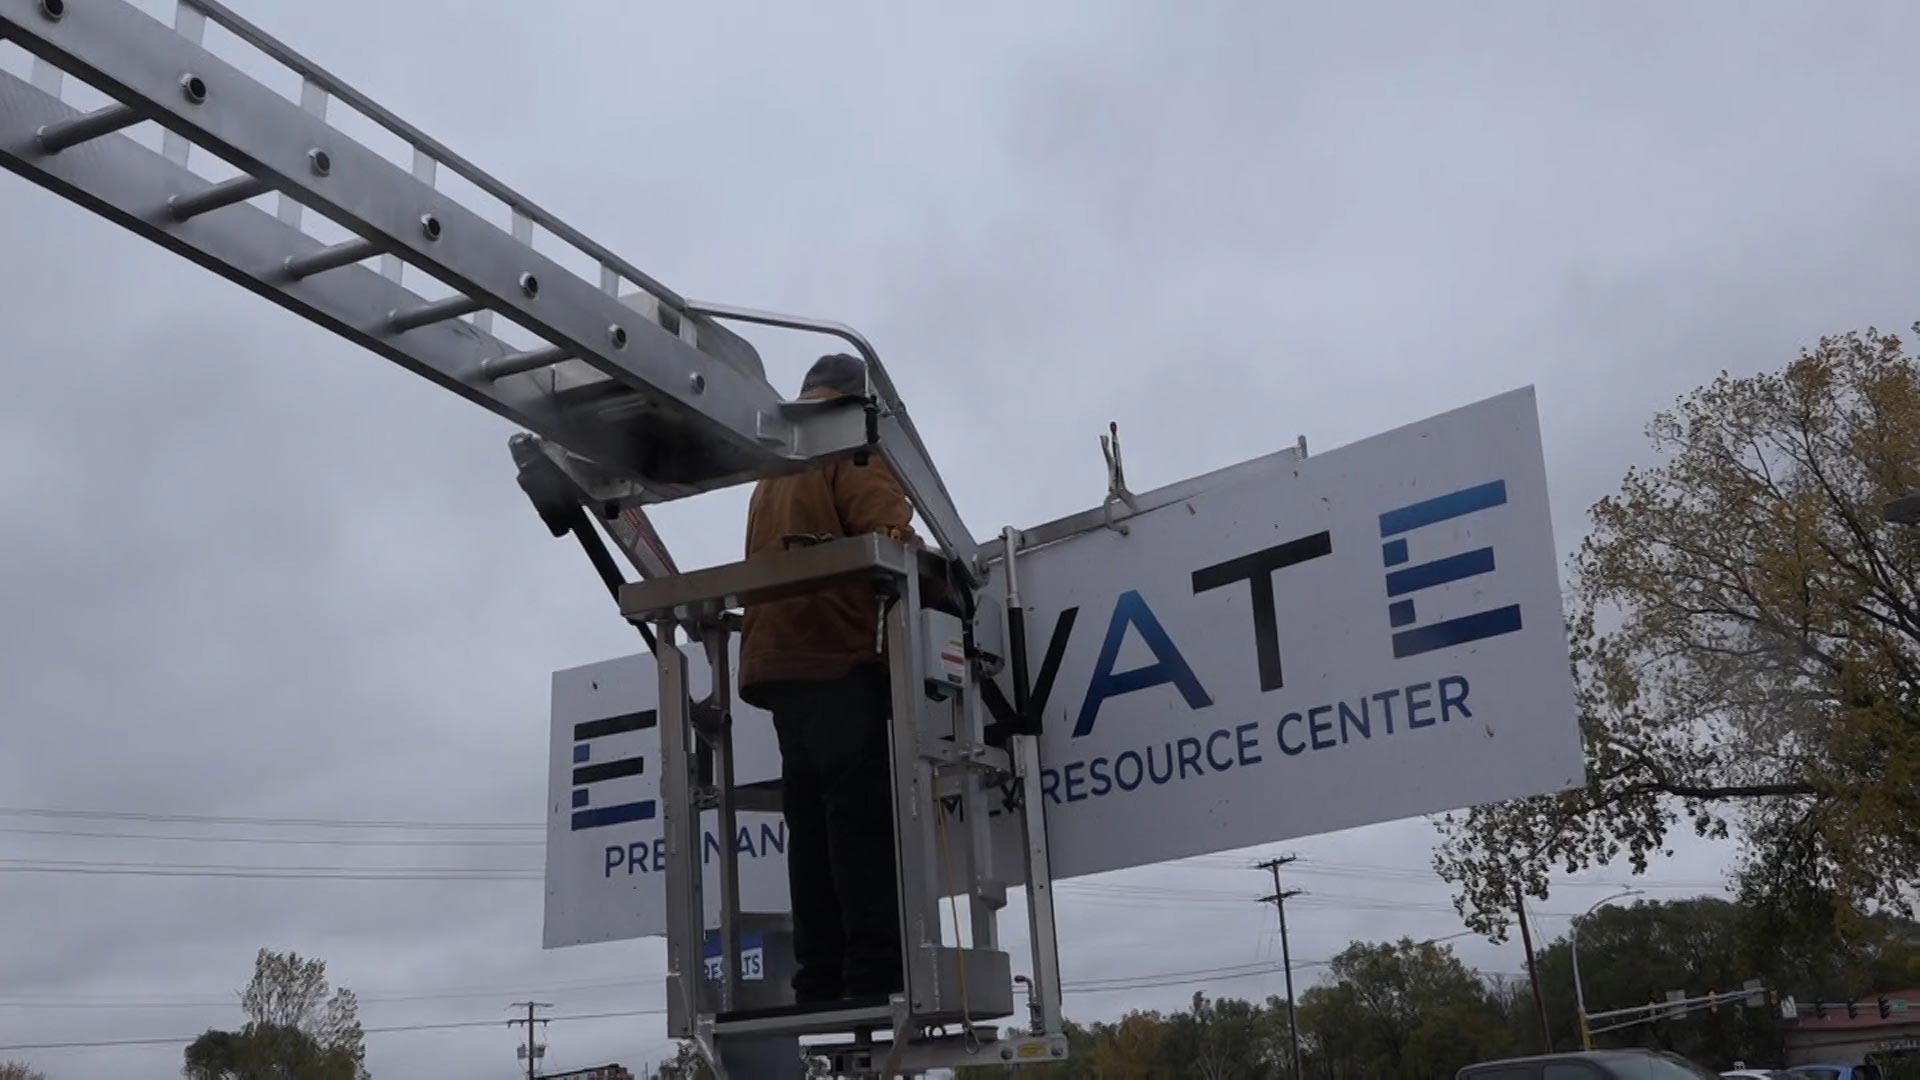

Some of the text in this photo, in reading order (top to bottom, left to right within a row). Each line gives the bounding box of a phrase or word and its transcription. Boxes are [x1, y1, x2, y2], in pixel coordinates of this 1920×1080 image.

[605, 821, 786, 878] PRENAN
[1041, 722, 1263, 805] RESOURCE
[1277, 674, 1473, 757] CENTER
